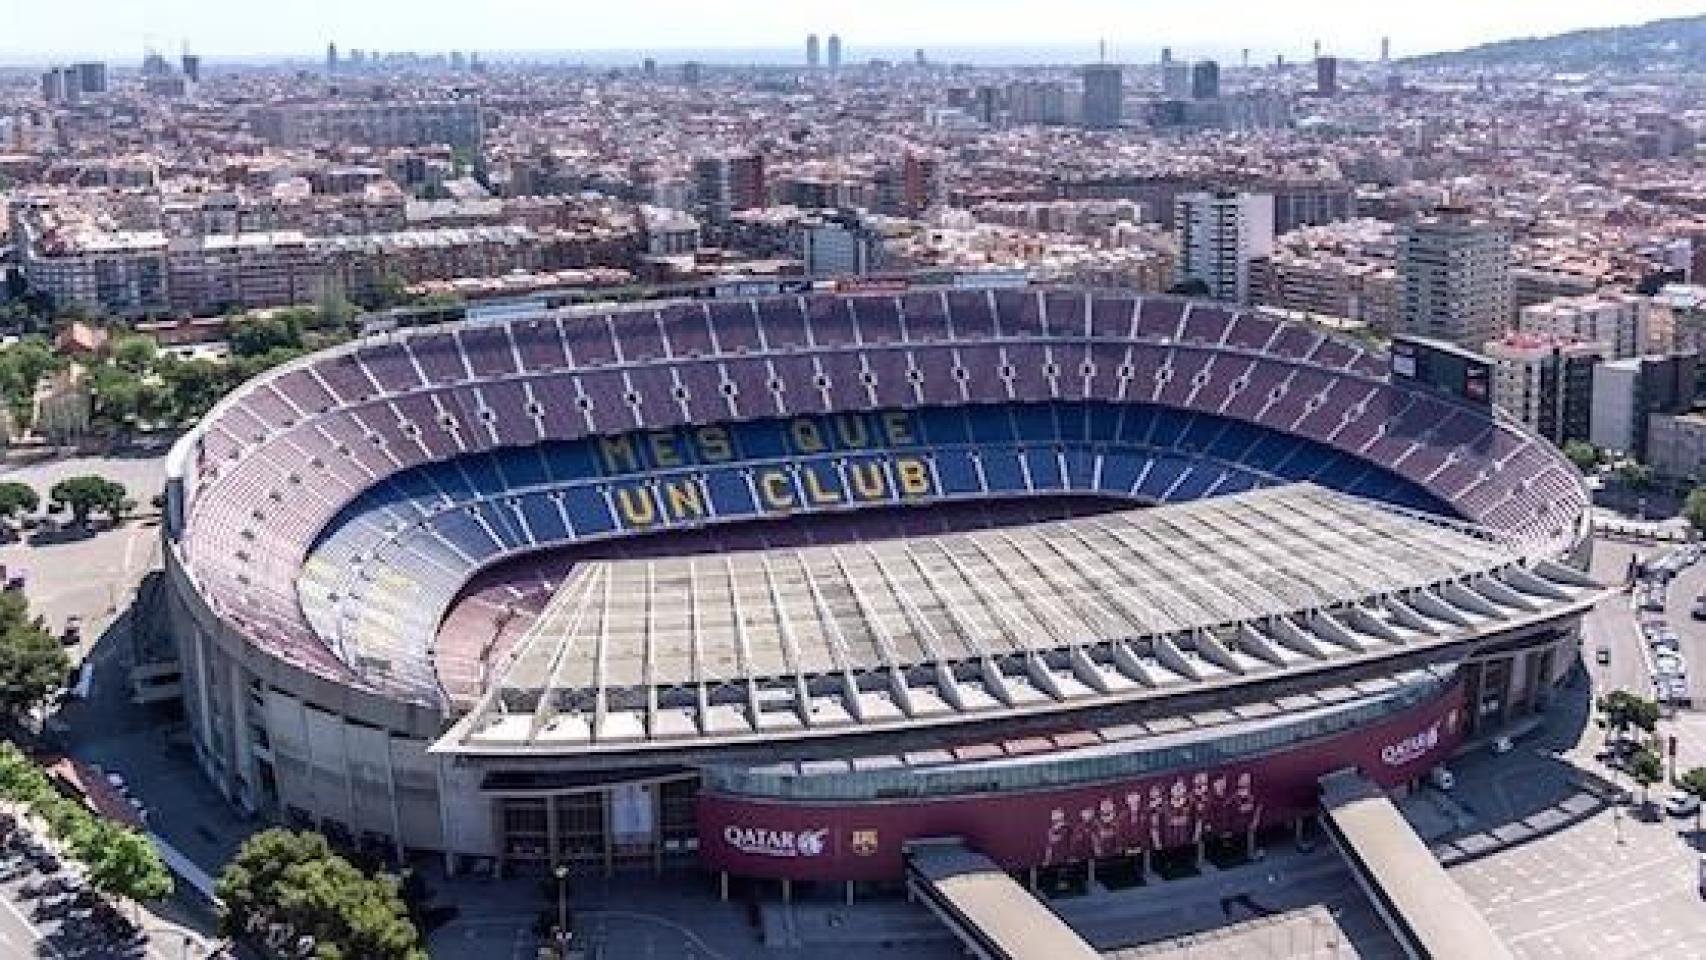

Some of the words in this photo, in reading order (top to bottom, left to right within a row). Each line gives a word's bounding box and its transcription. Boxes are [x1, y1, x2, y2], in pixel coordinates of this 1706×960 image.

[603, 428, 731, 471] MES
[794, 412, 913, 450] QUE
[618, 484, 701, 525] UN
[761, 460, 929, 506] CLUB
[724, 825, 796, 848] QATAR
